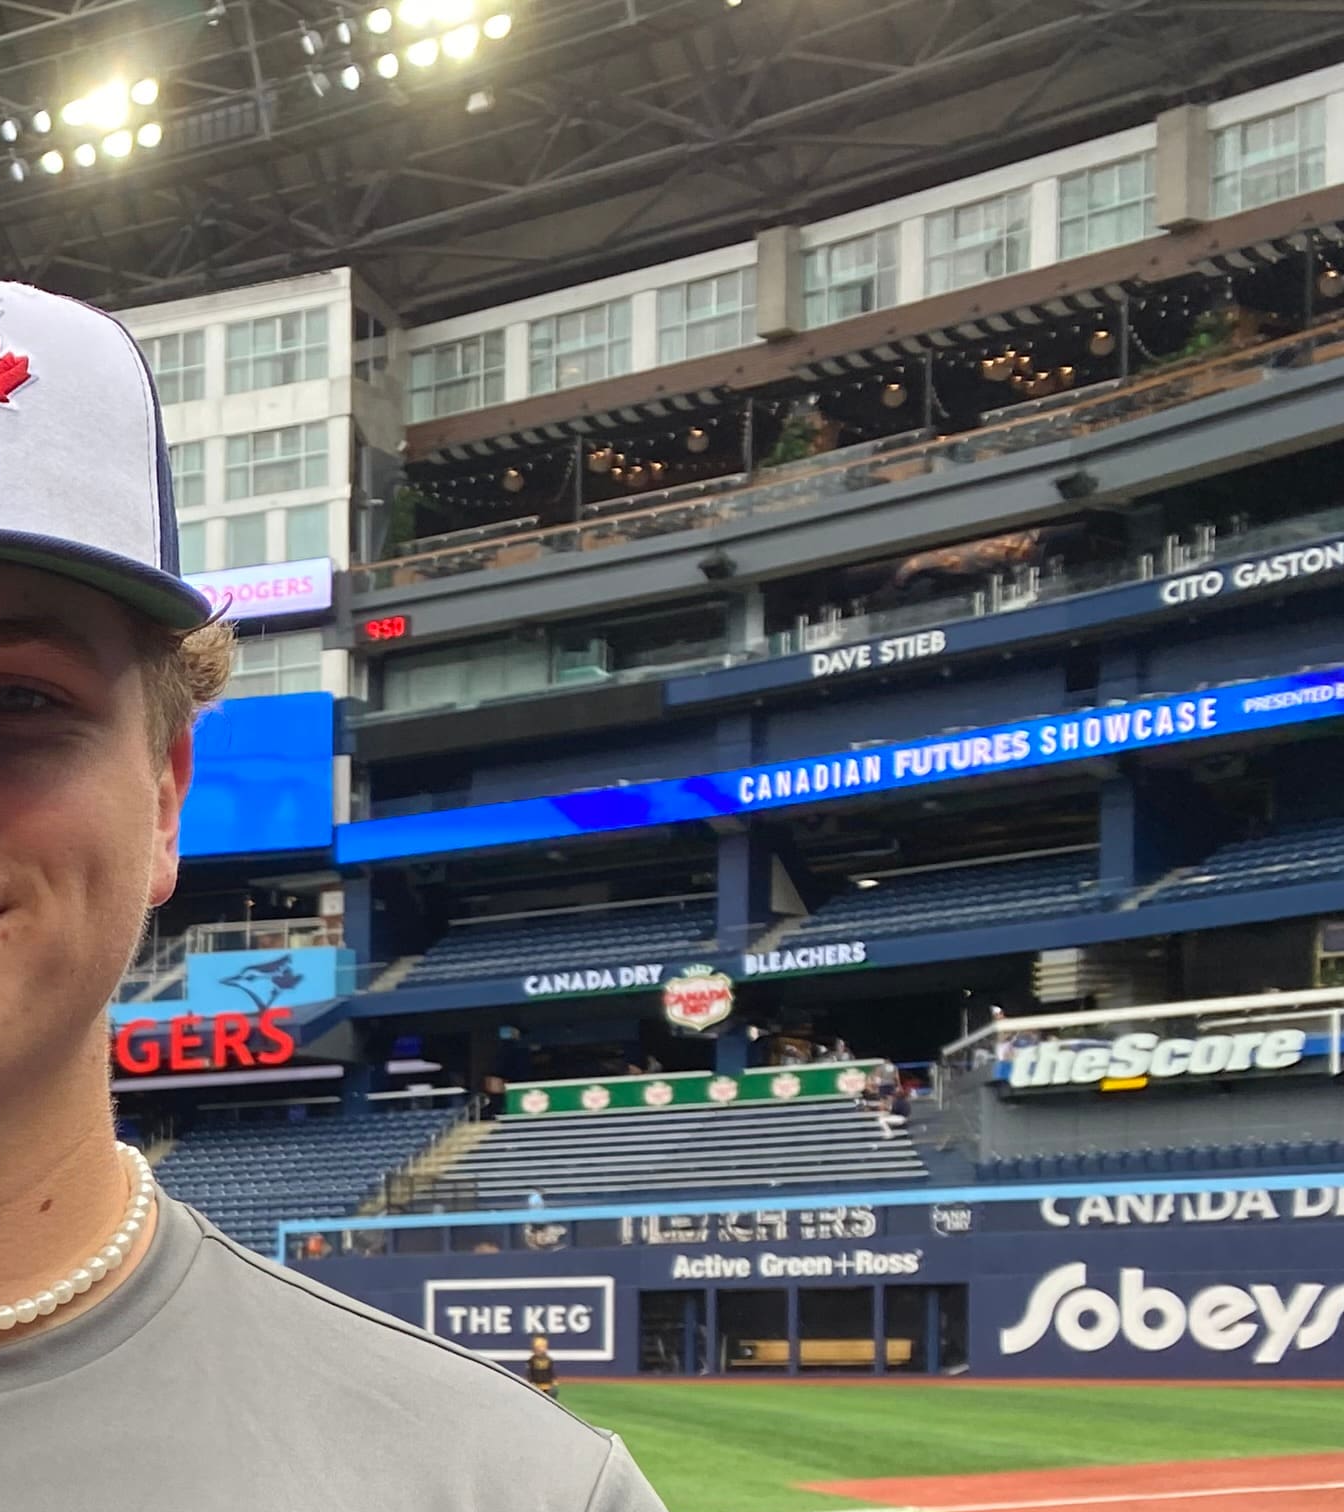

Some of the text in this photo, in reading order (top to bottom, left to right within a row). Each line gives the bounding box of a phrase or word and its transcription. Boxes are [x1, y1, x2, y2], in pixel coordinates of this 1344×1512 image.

[224, 575, 314, 604] ROGERS
[1162, 541, 1344, 604] CITO GASTON
[812, 630, 946, 677] DAVE STIEB
[739, 753, 882, 804] CANADIAN
[893, 729, 1030, 779] FUTURES
[1040, 698, 1217, 755] SHOWCASE
[523, 964, 664, 996] CANADA DRY
[743, 941, 868, 975] BLEACHERS
[116, 1008, 294, 1073] GERS
[1010, 1028, 1306, 1088] theScore
[673, 1253, 751, 1280] Active
[447, 1305, 592, 1335] THE KEG
[1000, 1262, 1344, 1363] Sobeys
